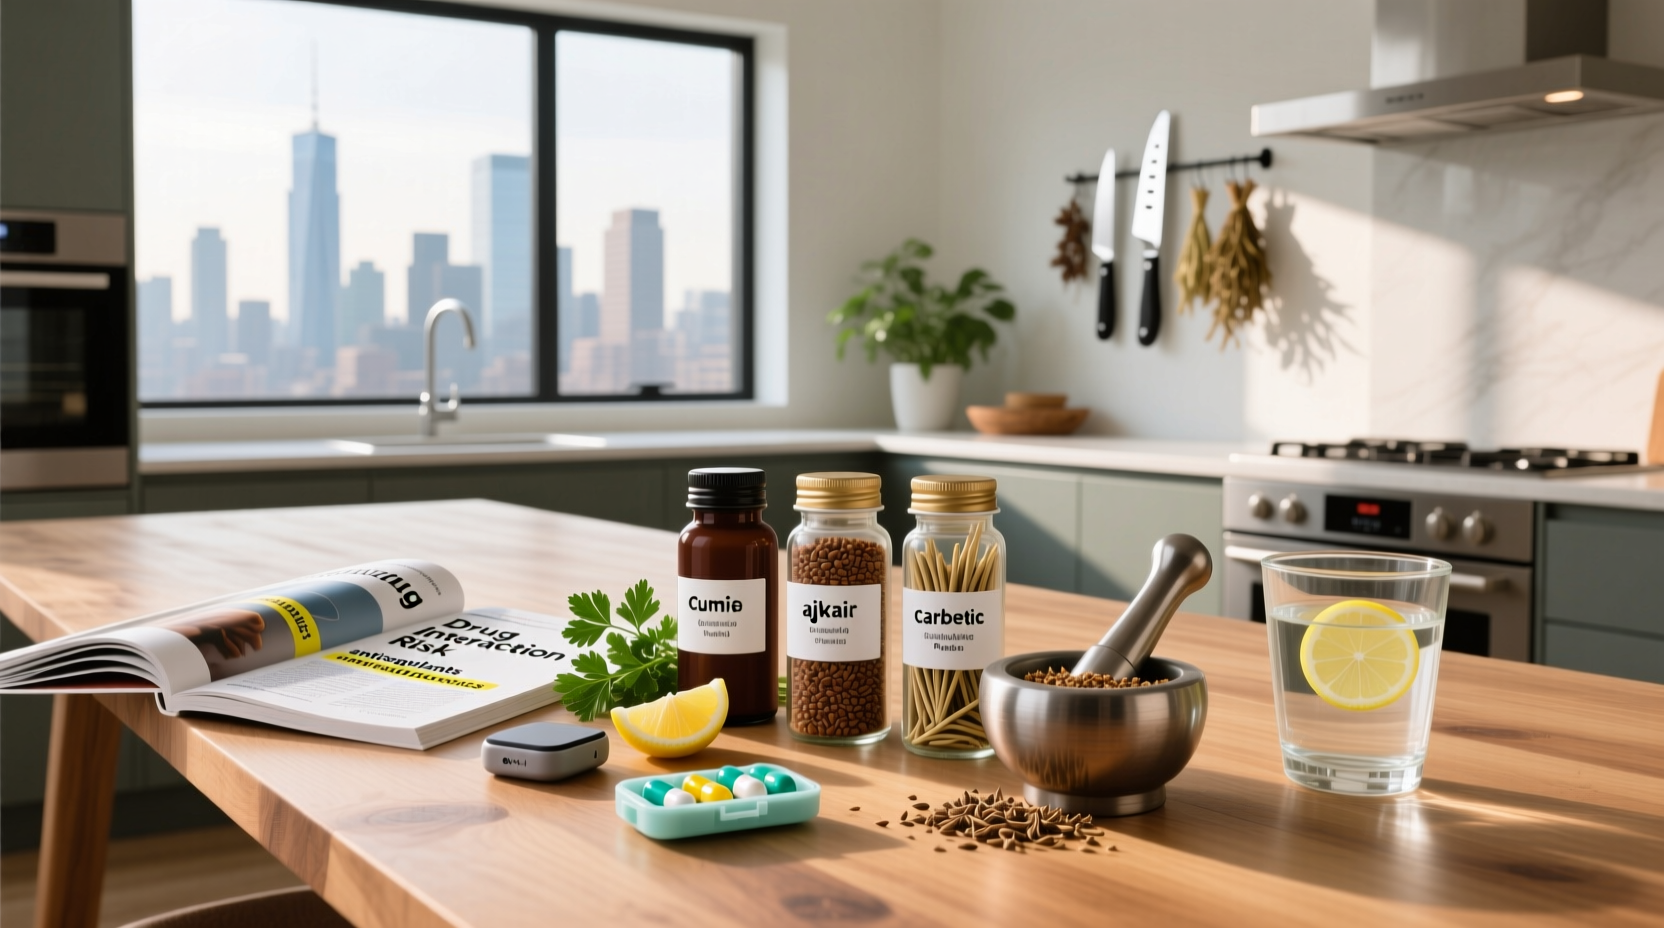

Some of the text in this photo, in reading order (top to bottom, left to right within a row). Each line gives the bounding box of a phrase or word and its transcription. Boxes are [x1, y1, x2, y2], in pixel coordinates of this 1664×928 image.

[802, 599, 858, 624] ajkair
[914, 608, 985, 626] Carbetic
[442, 618, 520, 642] Drug
[388, 635, 455, 657] Risk
[412, 626, 566, 661] Interaction
